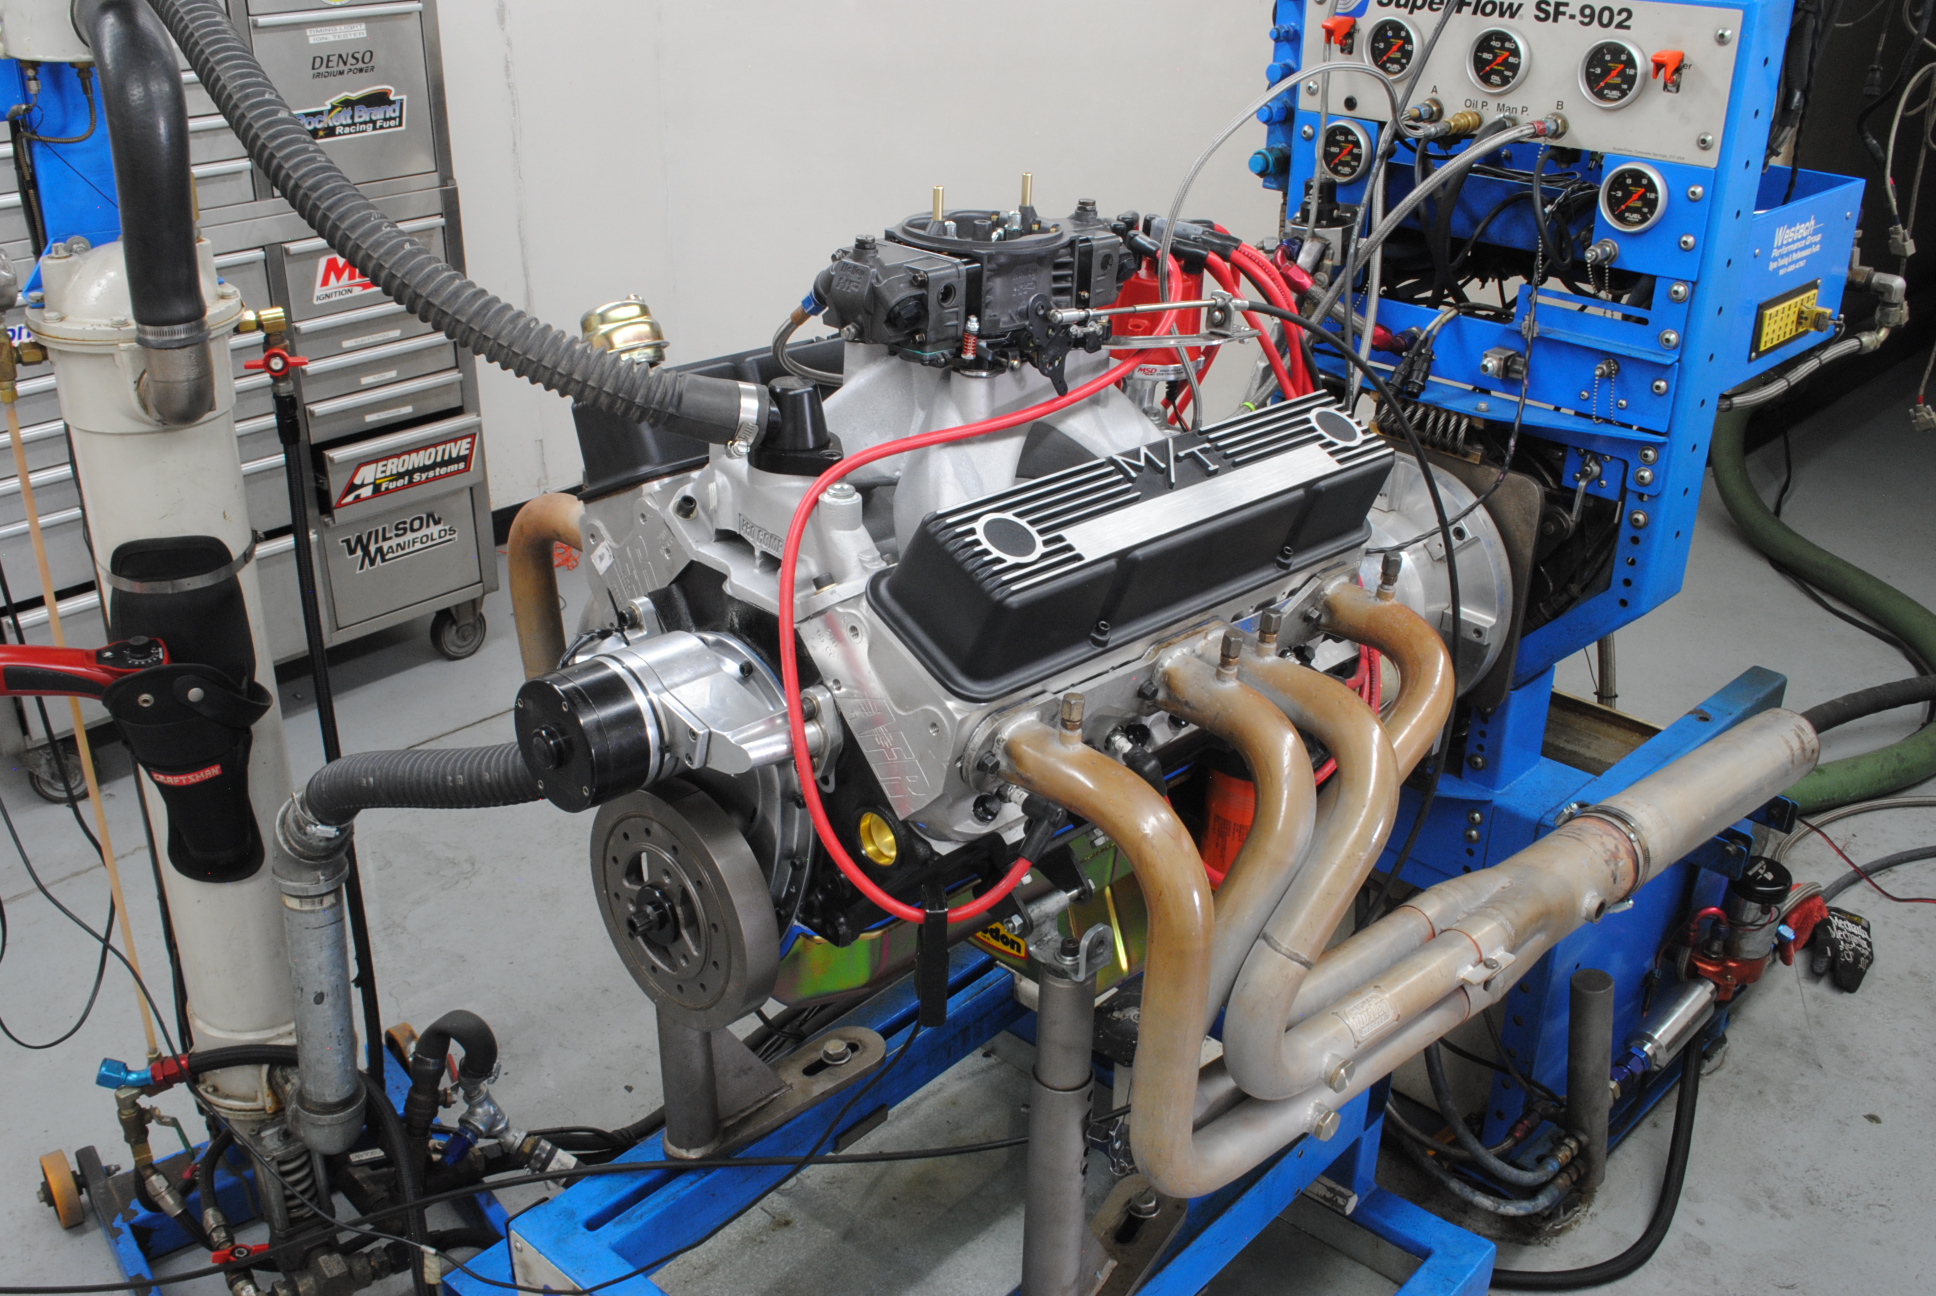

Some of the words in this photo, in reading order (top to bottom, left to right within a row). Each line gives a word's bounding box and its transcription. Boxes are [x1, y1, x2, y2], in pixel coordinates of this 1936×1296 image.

[1533, 0, 1633, 30] SF-902
[311, 50, 374, 71] DENSO
[312, 69, 345, 79] IRIDIUM
[347, 66, 375, 75] POWER
[1431, 85, 1438, 94] A
[354, 100, 400, 122] Brand
[1464, 98, 1478, 109] Oil
[1481, 101, 1489, 111] P.
[1496, 102, 1517, 114] Man
[1521, 105, 1529, 116] P.
[1556, 101, 1564, 110] B
[336, 122, 373, 135] Racing
[377, 118, 399, 129] Fuel
[1774, 215, 1820, 248] Westech
[1771, 239, 1806, 258] Performance
[1805, 233, 1822, 245] Group
[316, 288, 354, 301] IGNITION
[341, 437, 472, 504] AEROMOTIVE
[381, 477, 408, 491] Fuel
[413, 461, 465, 481] Systems
[341, 511, 442, 557] WILSON
[357, 526, 457, 572] MANIFOLDS
[153, 767, 221, 784] CRAFTSMAN
